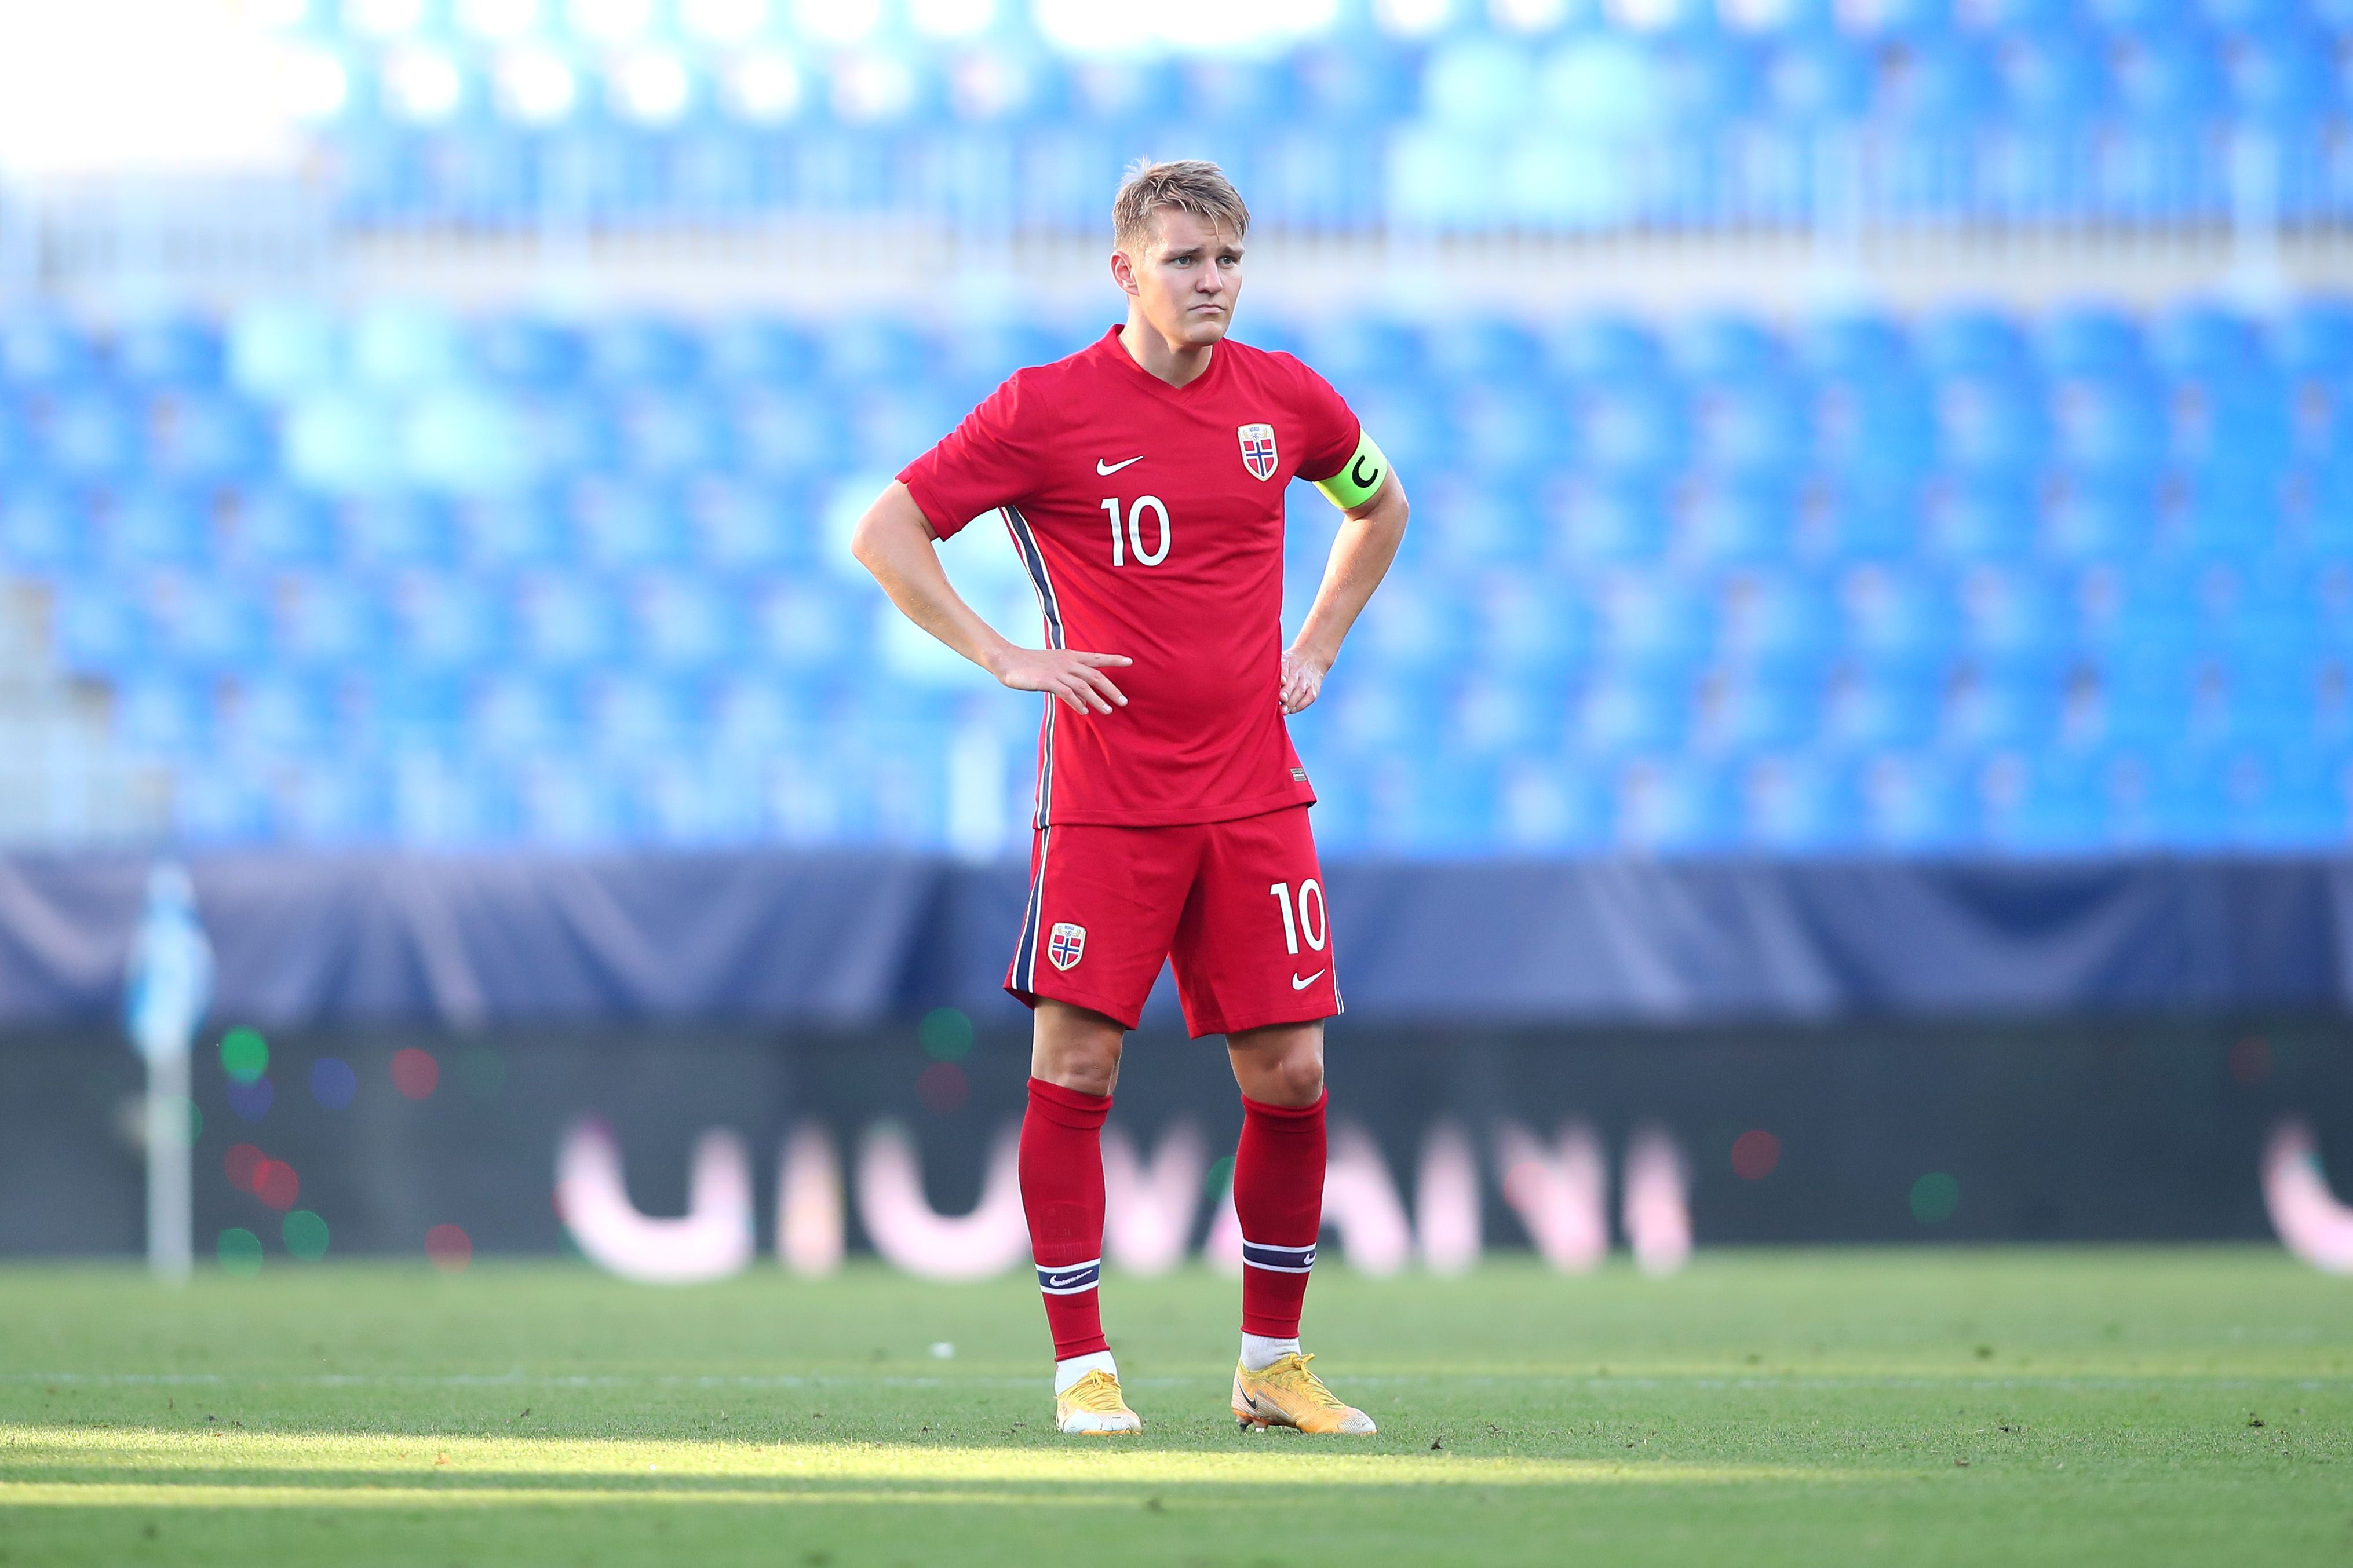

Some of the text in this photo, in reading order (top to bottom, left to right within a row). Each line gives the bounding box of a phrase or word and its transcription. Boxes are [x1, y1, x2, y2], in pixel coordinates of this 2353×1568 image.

[1352, 455, 1378, 488] C
[1101, 495, 1171, 566] 10
[1270, 878, 1326, 955] 10
